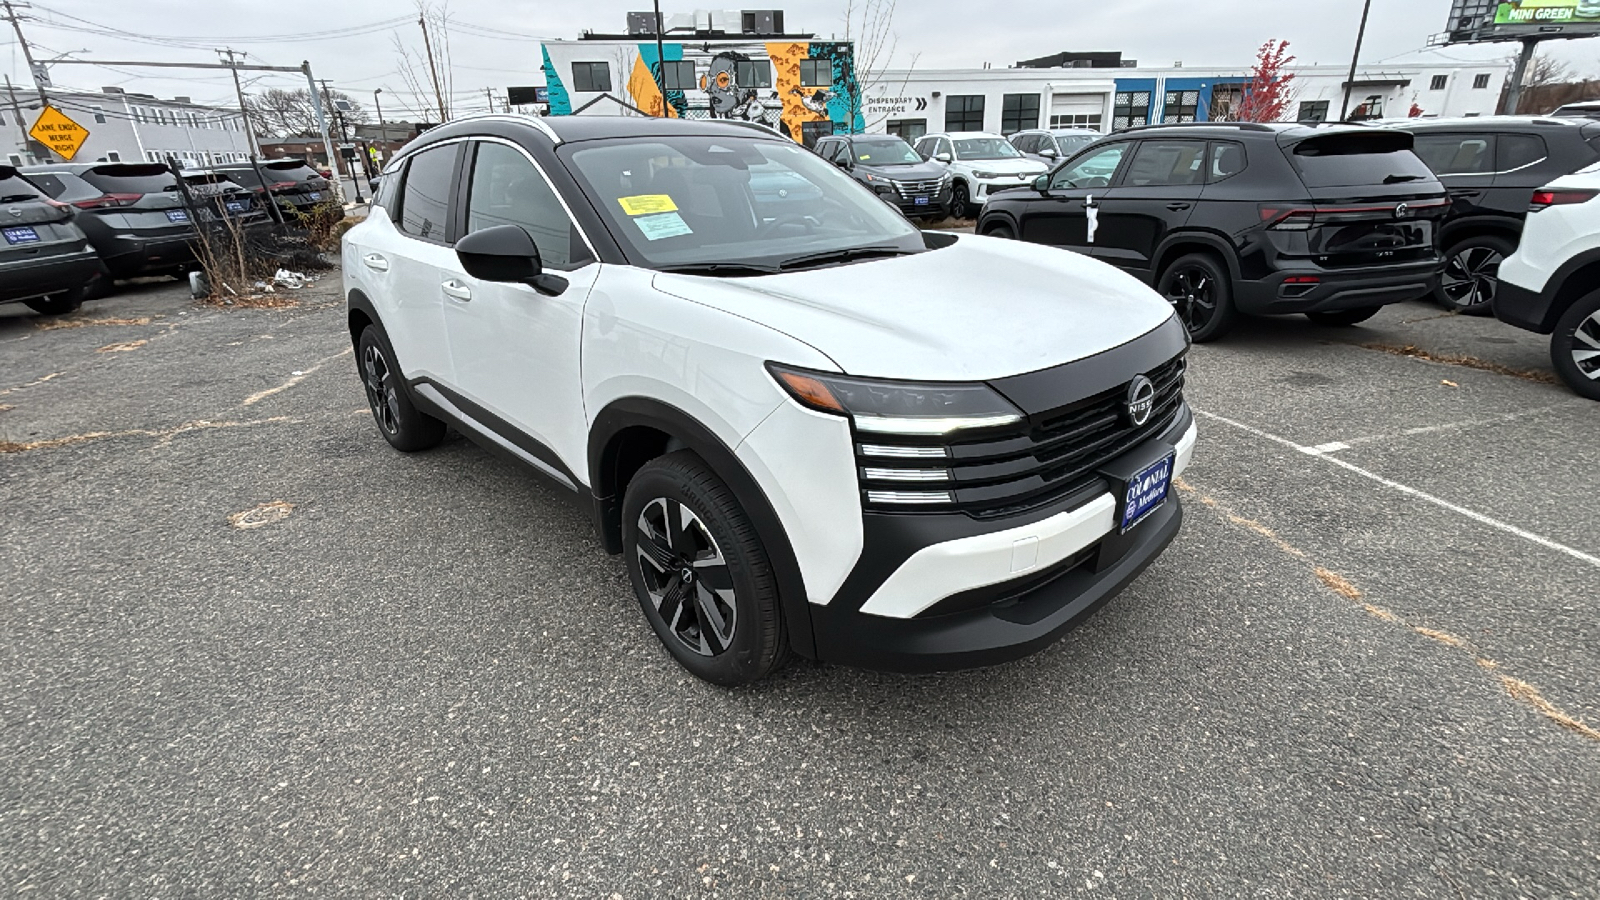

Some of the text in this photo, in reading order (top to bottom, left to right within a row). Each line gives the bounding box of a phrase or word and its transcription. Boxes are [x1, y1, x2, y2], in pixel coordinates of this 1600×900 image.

[1508, 7, 1574, 20] MINI GREEN
[868, 97, 912, 105] DISPENSARY
[37, 124, 56, 132] LANE
[1129, 400, 1151, 413] NISS
[1126, 465, 1169, 503] COLONIAL
[1138, 482, 1166, 509] Medford
